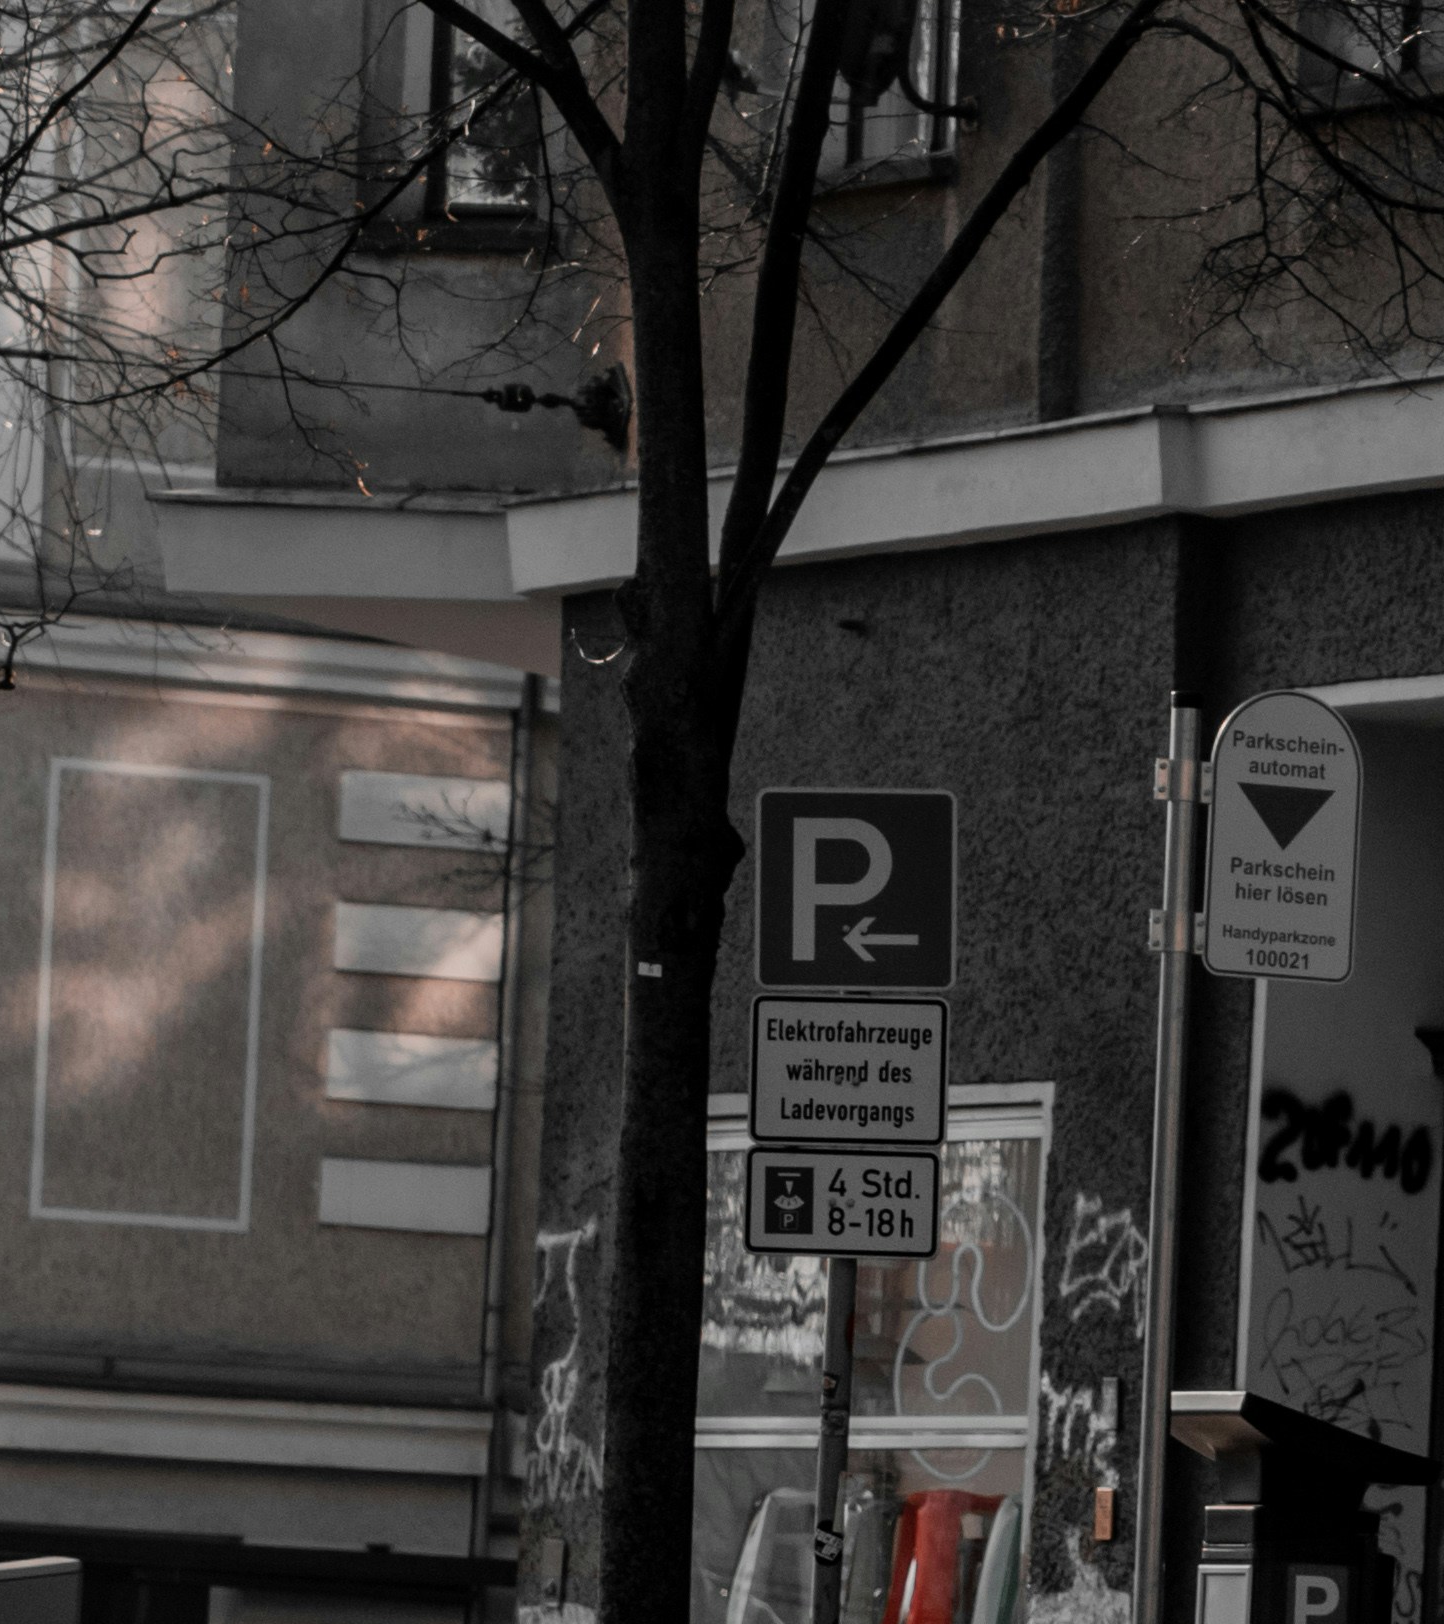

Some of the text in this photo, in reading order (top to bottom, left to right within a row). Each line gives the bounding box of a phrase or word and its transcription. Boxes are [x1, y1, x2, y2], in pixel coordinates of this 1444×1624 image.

[1233, 730, 1345, 756] Parkschein-
[1249, 760, 1326, 780] automat
[1230, 857, 1335, 882] Parkschein
[792, 817, 893, 961] P
[1235, 883, 1328, 906] hier lösen
[1222, 924, 1336, 947] Handyparkzone
[1246, 948, 1310, 970] 100021
[766, 1018, 933, 1050] Elektrofahrzeuge
[786, 1059, 912, 1087] während des
[781, 1097, 915, 1128] Ladevorgangs
[828, 1168, 921, 1199] 4 Std.
